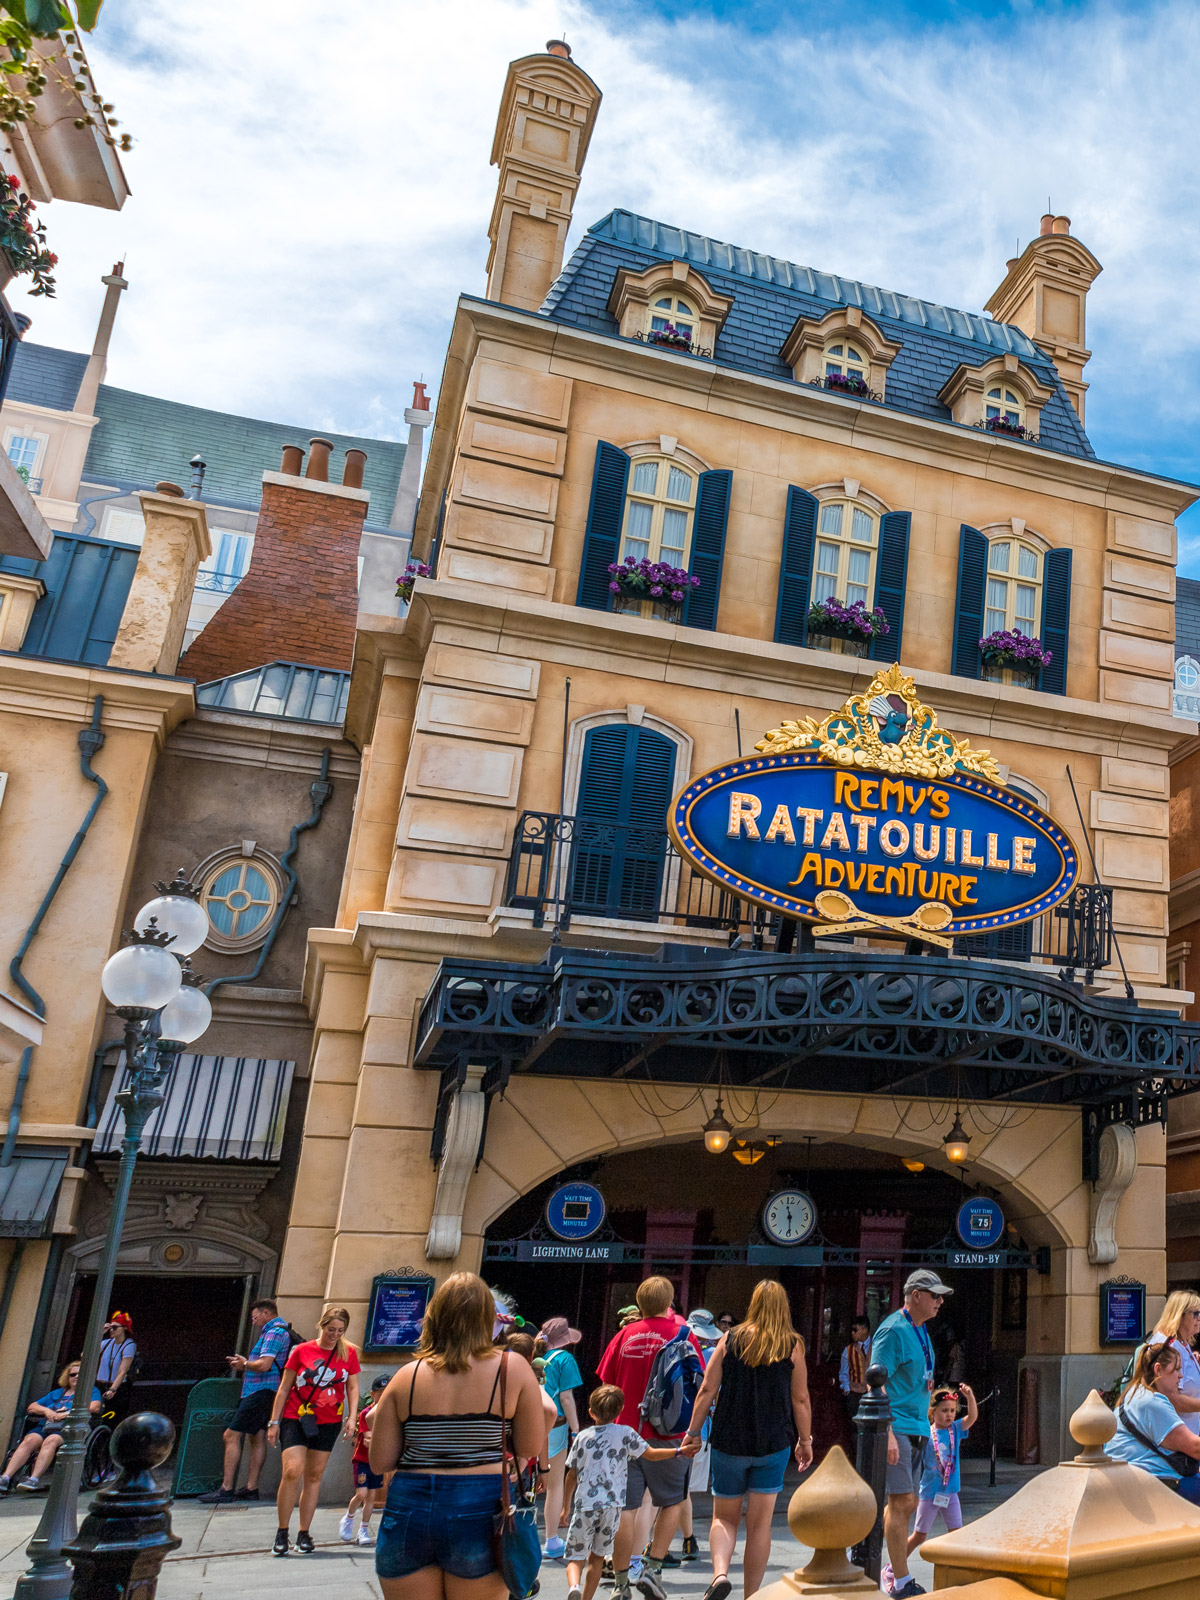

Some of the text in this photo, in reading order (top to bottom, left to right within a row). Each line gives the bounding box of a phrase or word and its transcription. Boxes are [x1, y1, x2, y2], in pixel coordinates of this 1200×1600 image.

[834, 771, 949, 818] REMY'S
[726, 792, 1036, 875] RATATOUILLE
[788, 853, 978, 907] ADVENTURE
[786, 1196, 795, 1204] 12
[771, 1212, 776, 1221] 9
[804, 1213, 809, 1221] 3
[978, 1218, 989, 1227] 75
[786, 1229, 791, 1237] 6
[532, 1246, 609, 1258] LIGHTNING LANE
[954, 1254, 1000, 1263] STAND-BY
